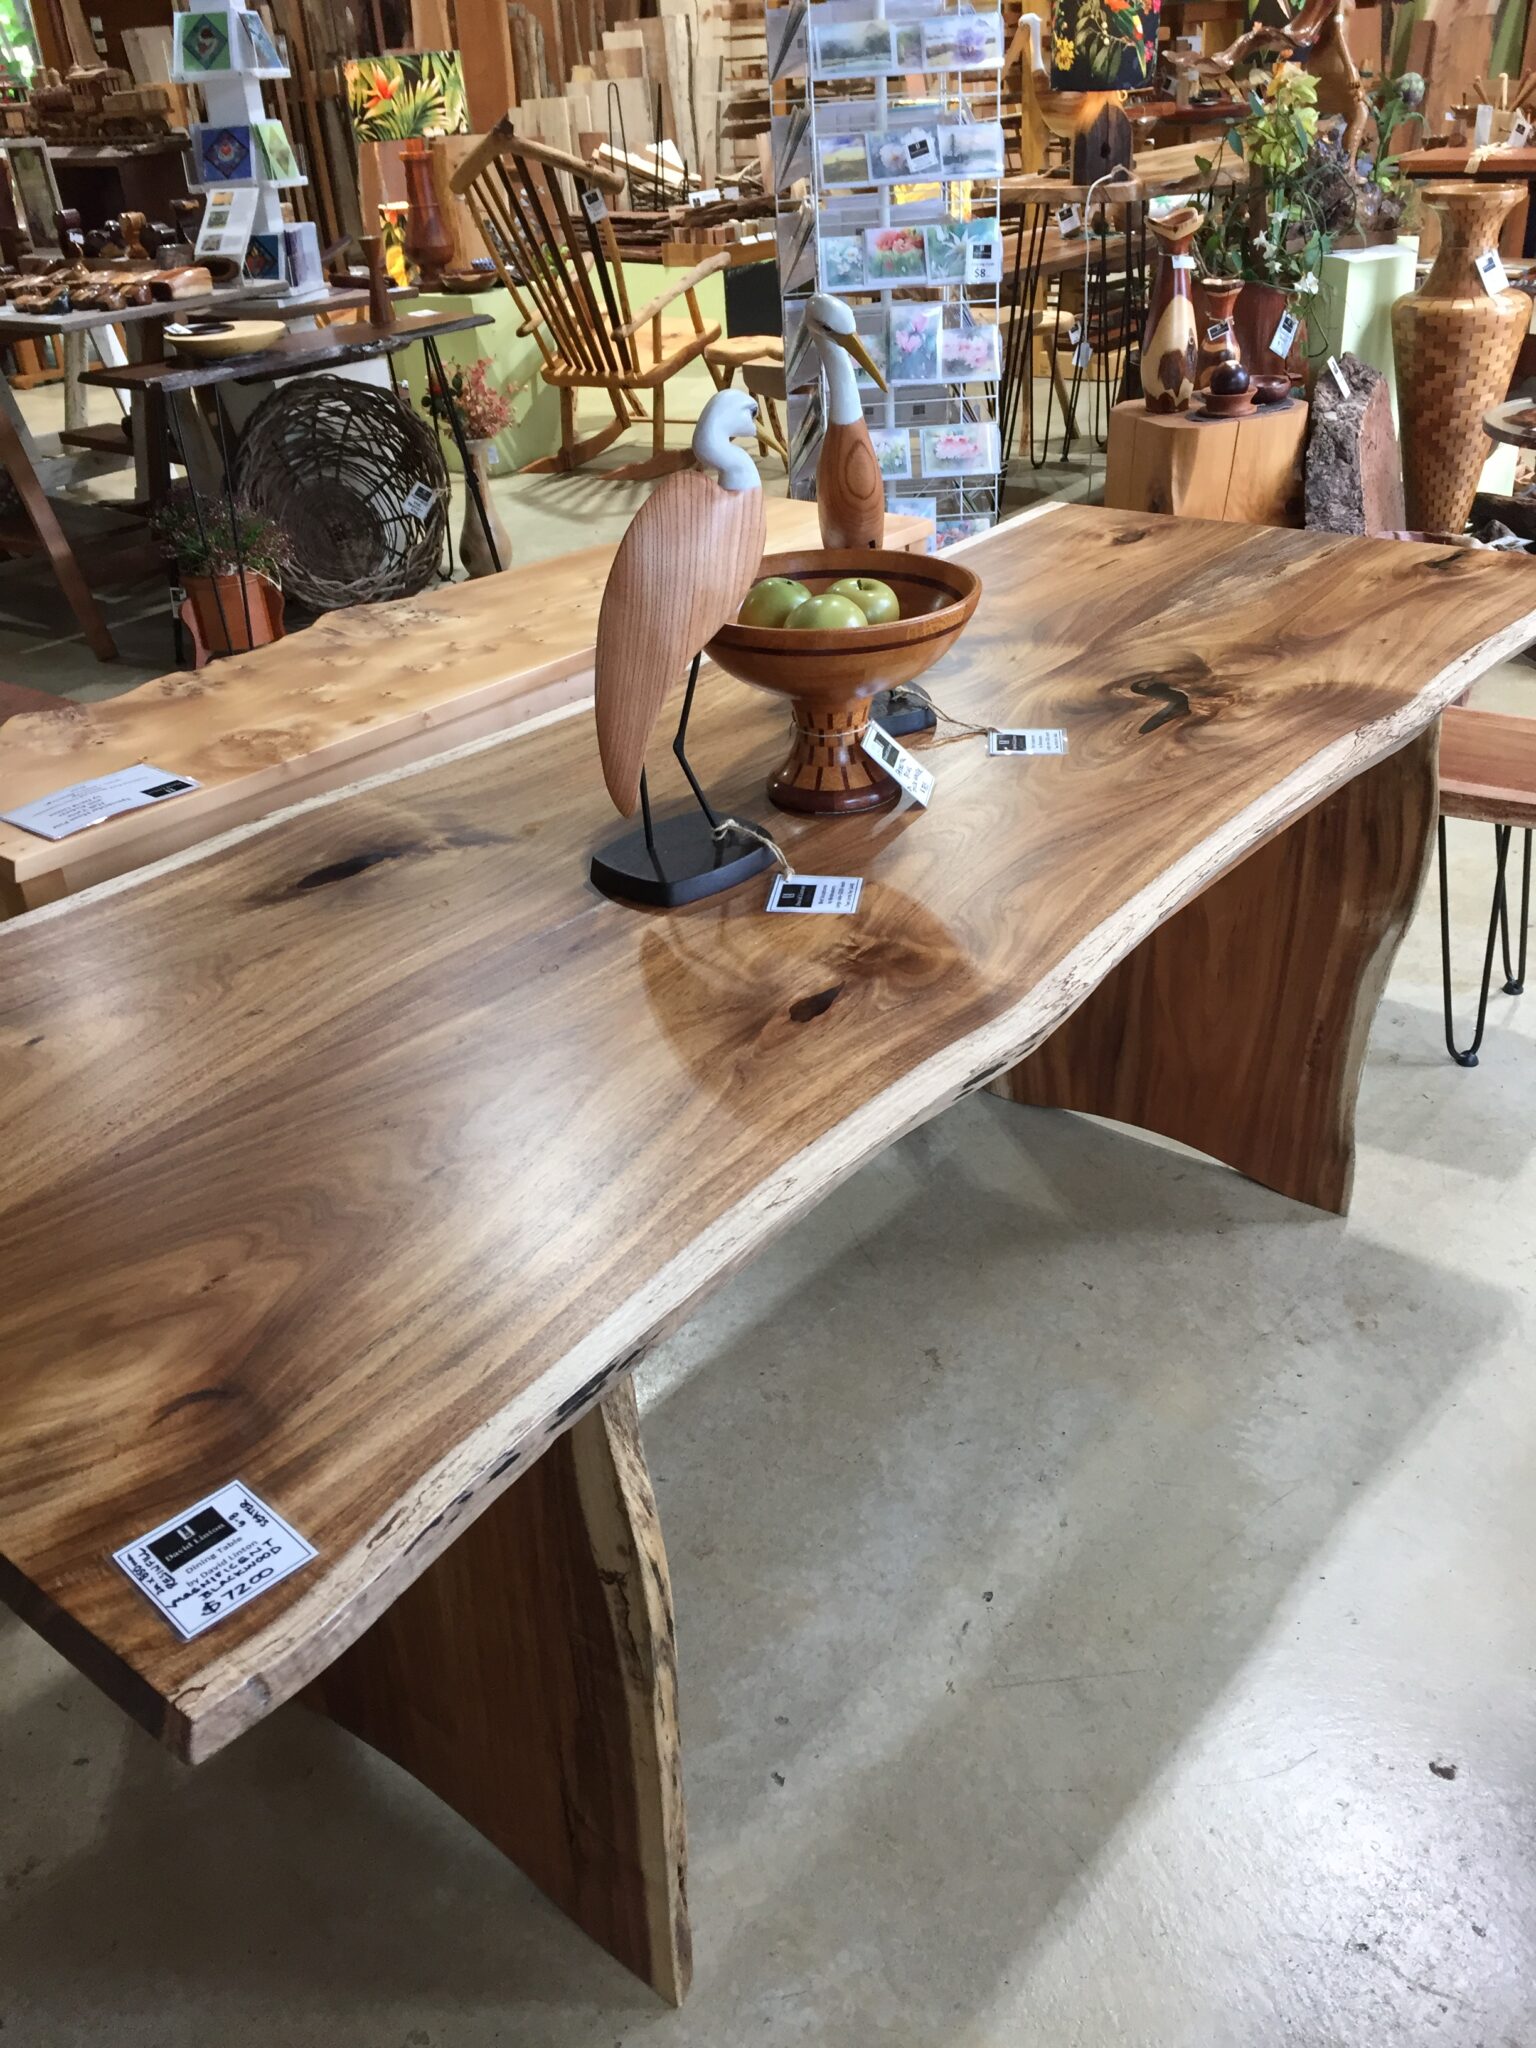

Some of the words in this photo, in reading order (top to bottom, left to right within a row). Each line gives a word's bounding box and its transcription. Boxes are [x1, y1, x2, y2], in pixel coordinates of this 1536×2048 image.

[974, 268, 986, 278] $8
[240, 1499, 269, 1527] SEATER
[139, 1548, 157, 1569] FILL
[165, 1543, 193, 1562] David
[193, 1523, 225, 1546] Linton
[186, 1552, 217, 1575] Dining
[217, 1537, 242, 1557] Table
[154, 1565, 178, 1590] RESIN
[166, 1539, 273, 1609] MAGNIFICENT
[186, 1577, 199, 1587] by
[200, 1562, 226, 1579] David
[227, 1540, 258, 1565] Linton
[198, 1546, 282, 1600] BLACKWOOD
